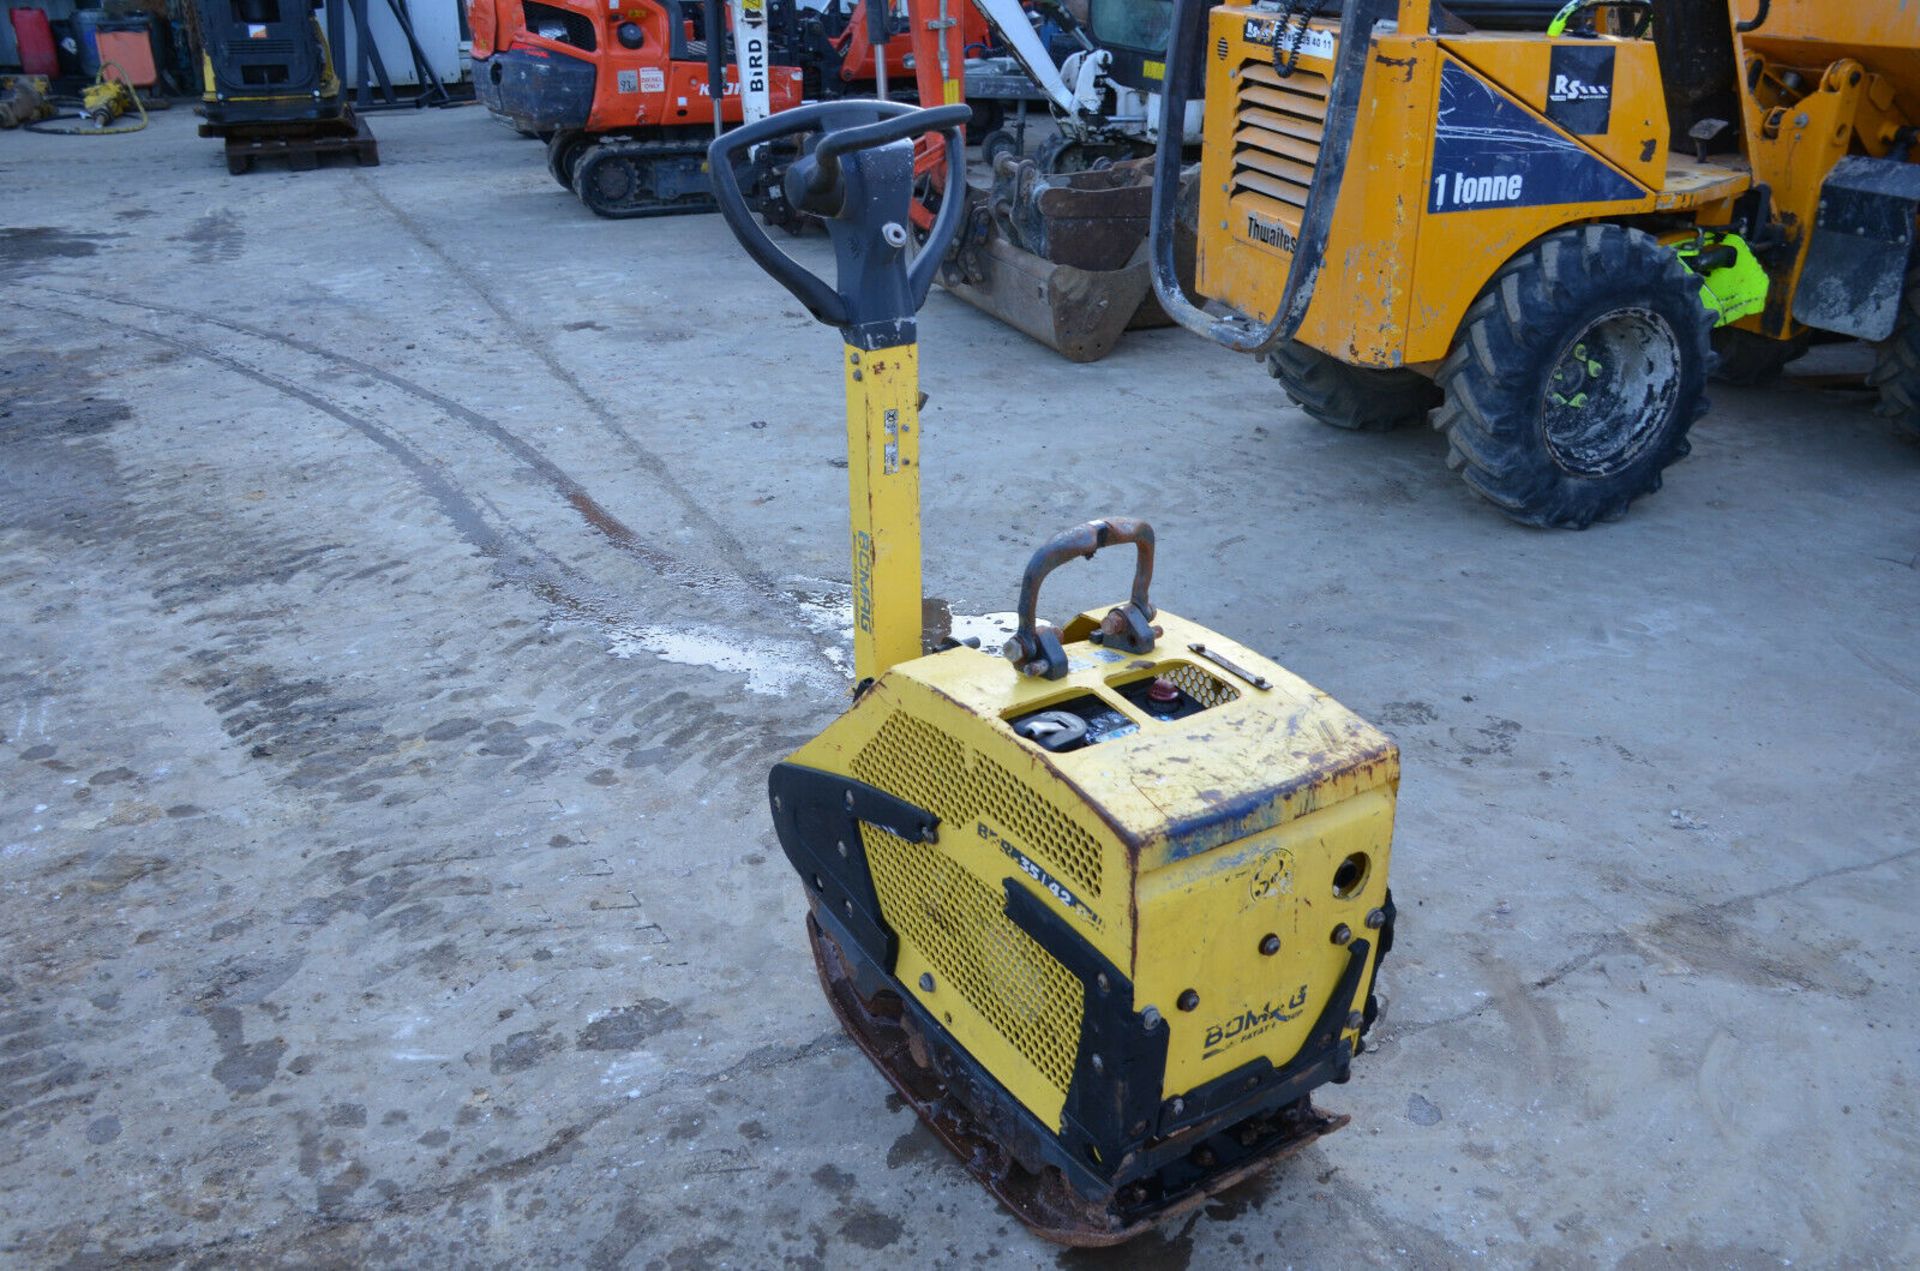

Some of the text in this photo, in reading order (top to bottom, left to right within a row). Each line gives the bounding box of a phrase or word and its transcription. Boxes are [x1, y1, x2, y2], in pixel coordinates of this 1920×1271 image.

[1435, 172, 1523, 206] 1 tonne
[1248, 216, 1297, 254] Thwaites
